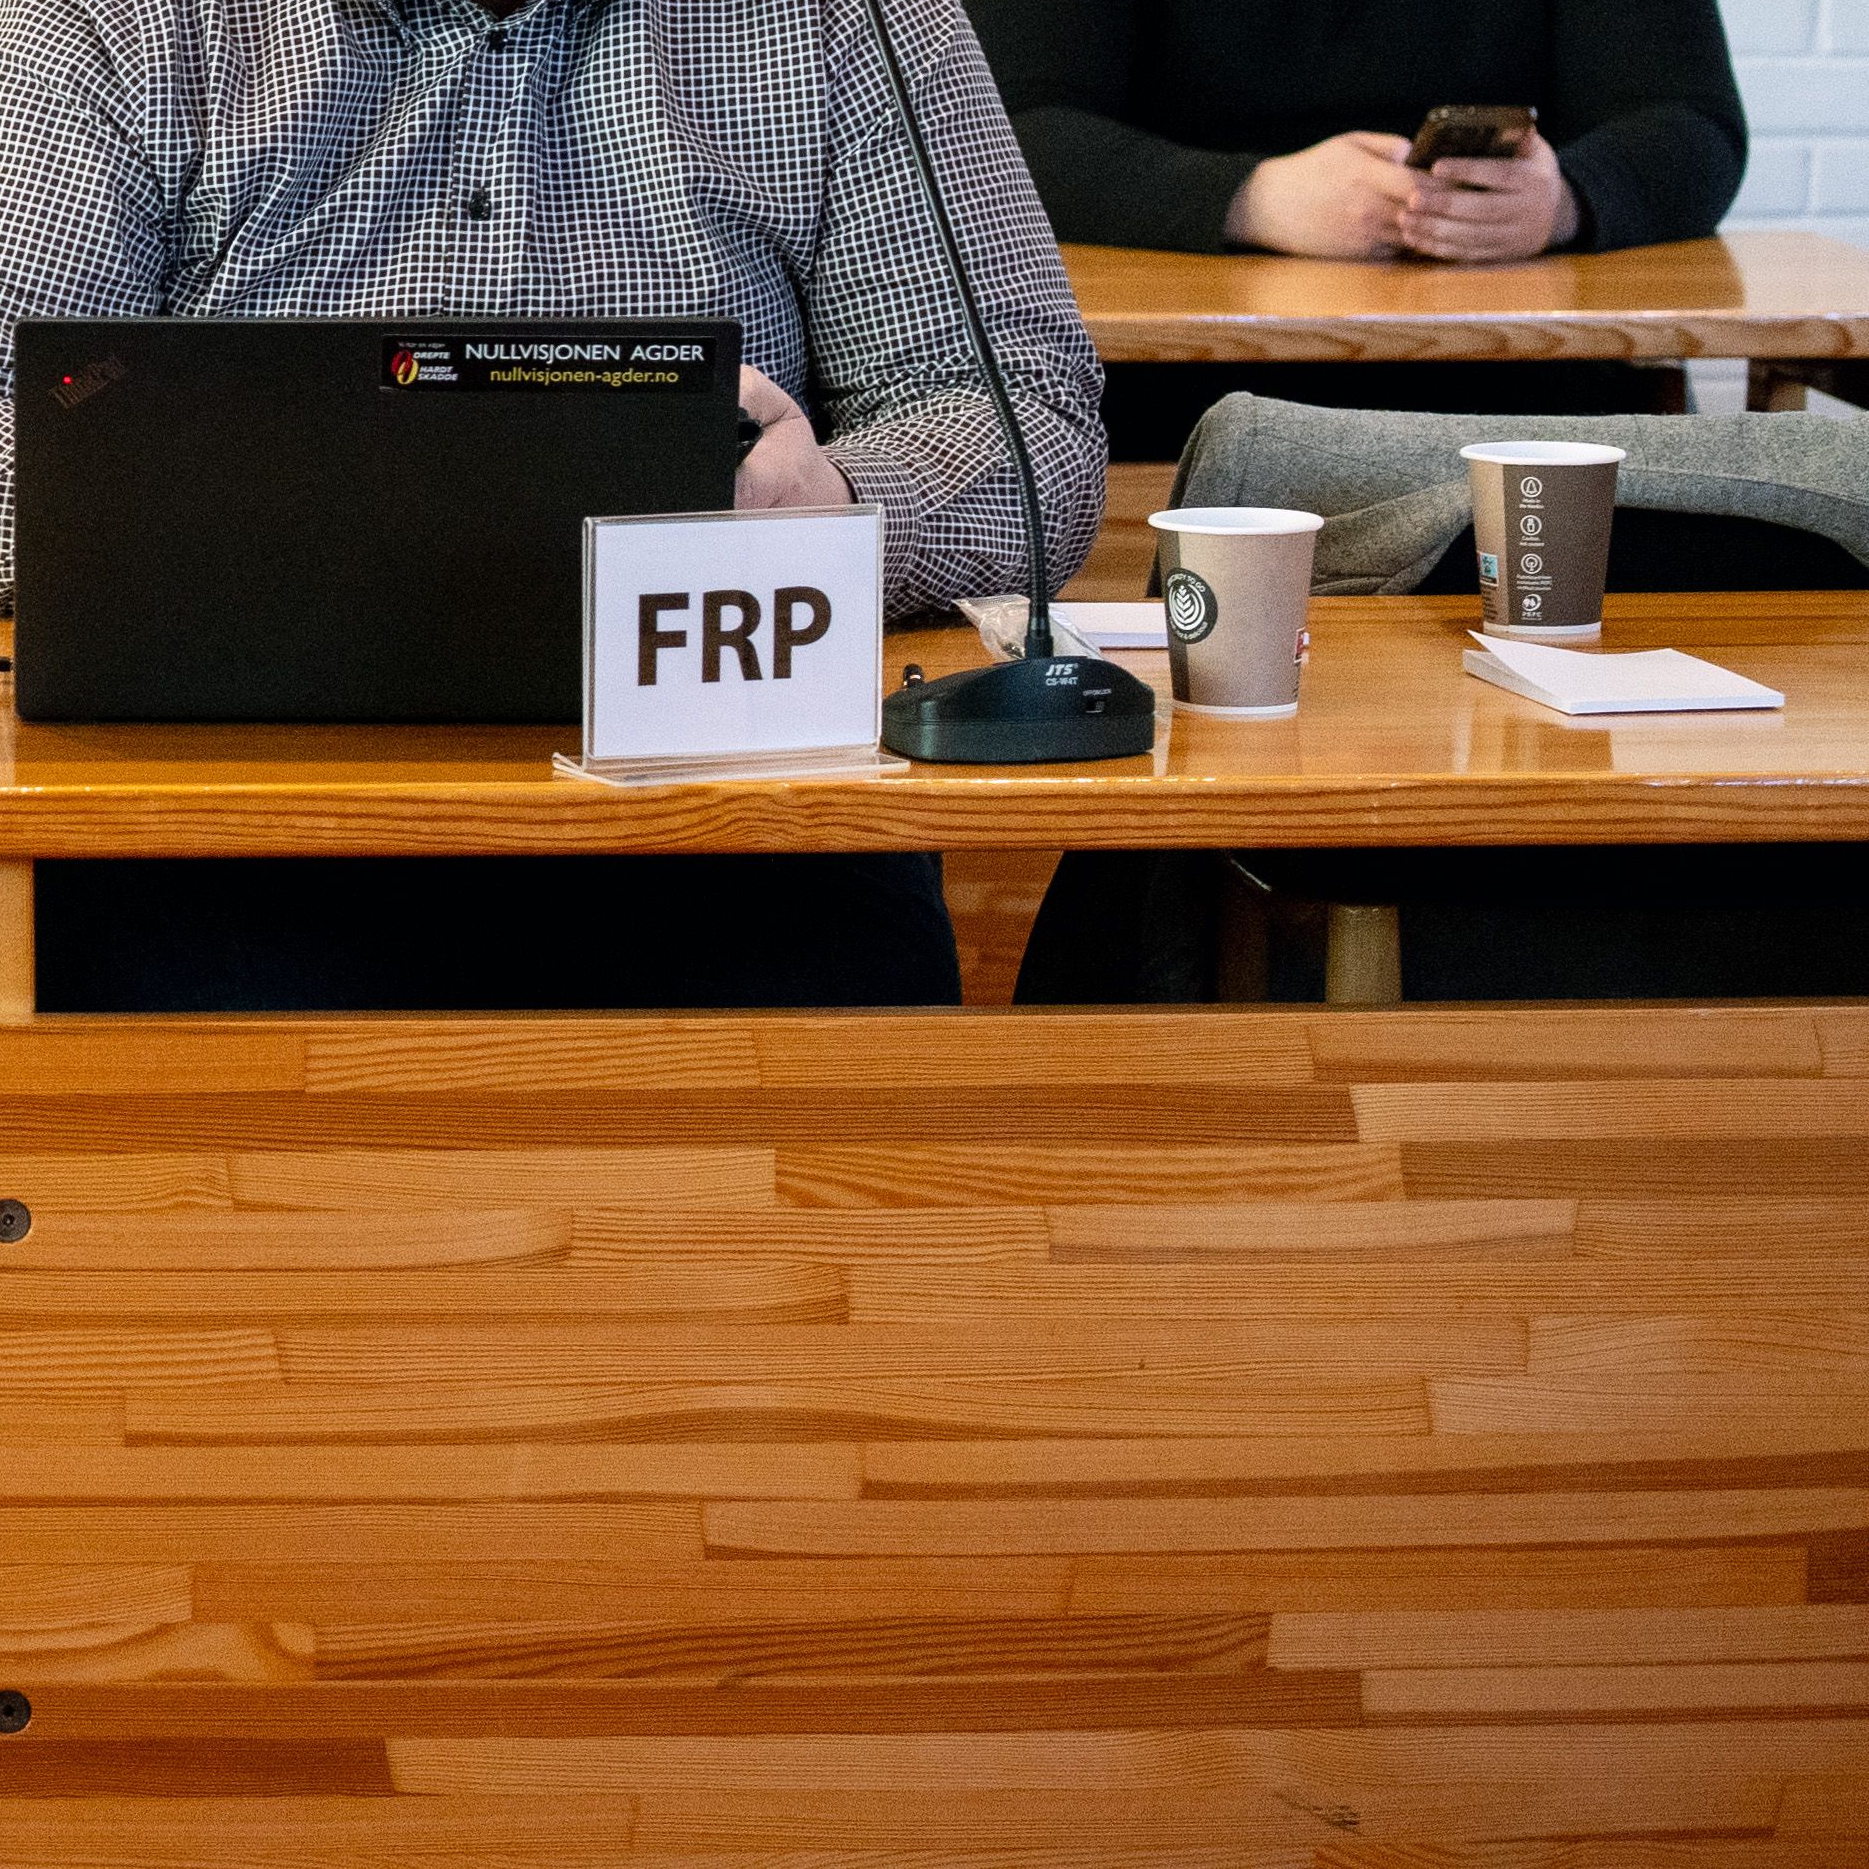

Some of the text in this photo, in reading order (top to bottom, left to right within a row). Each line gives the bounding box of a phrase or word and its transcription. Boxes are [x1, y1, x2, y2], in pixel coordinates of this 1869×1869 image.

[413, 351, 451, 360] DREPTE
[465, 344, 705, 364] NULLVISJONEN AGDER
[417, 373, 459, 381] SKADDE
[419, 366, 454, 374] HARDT
[490, 367, 679, 387] nullvisjonen-agder.no
[638, 585, 832, 686] FRP
